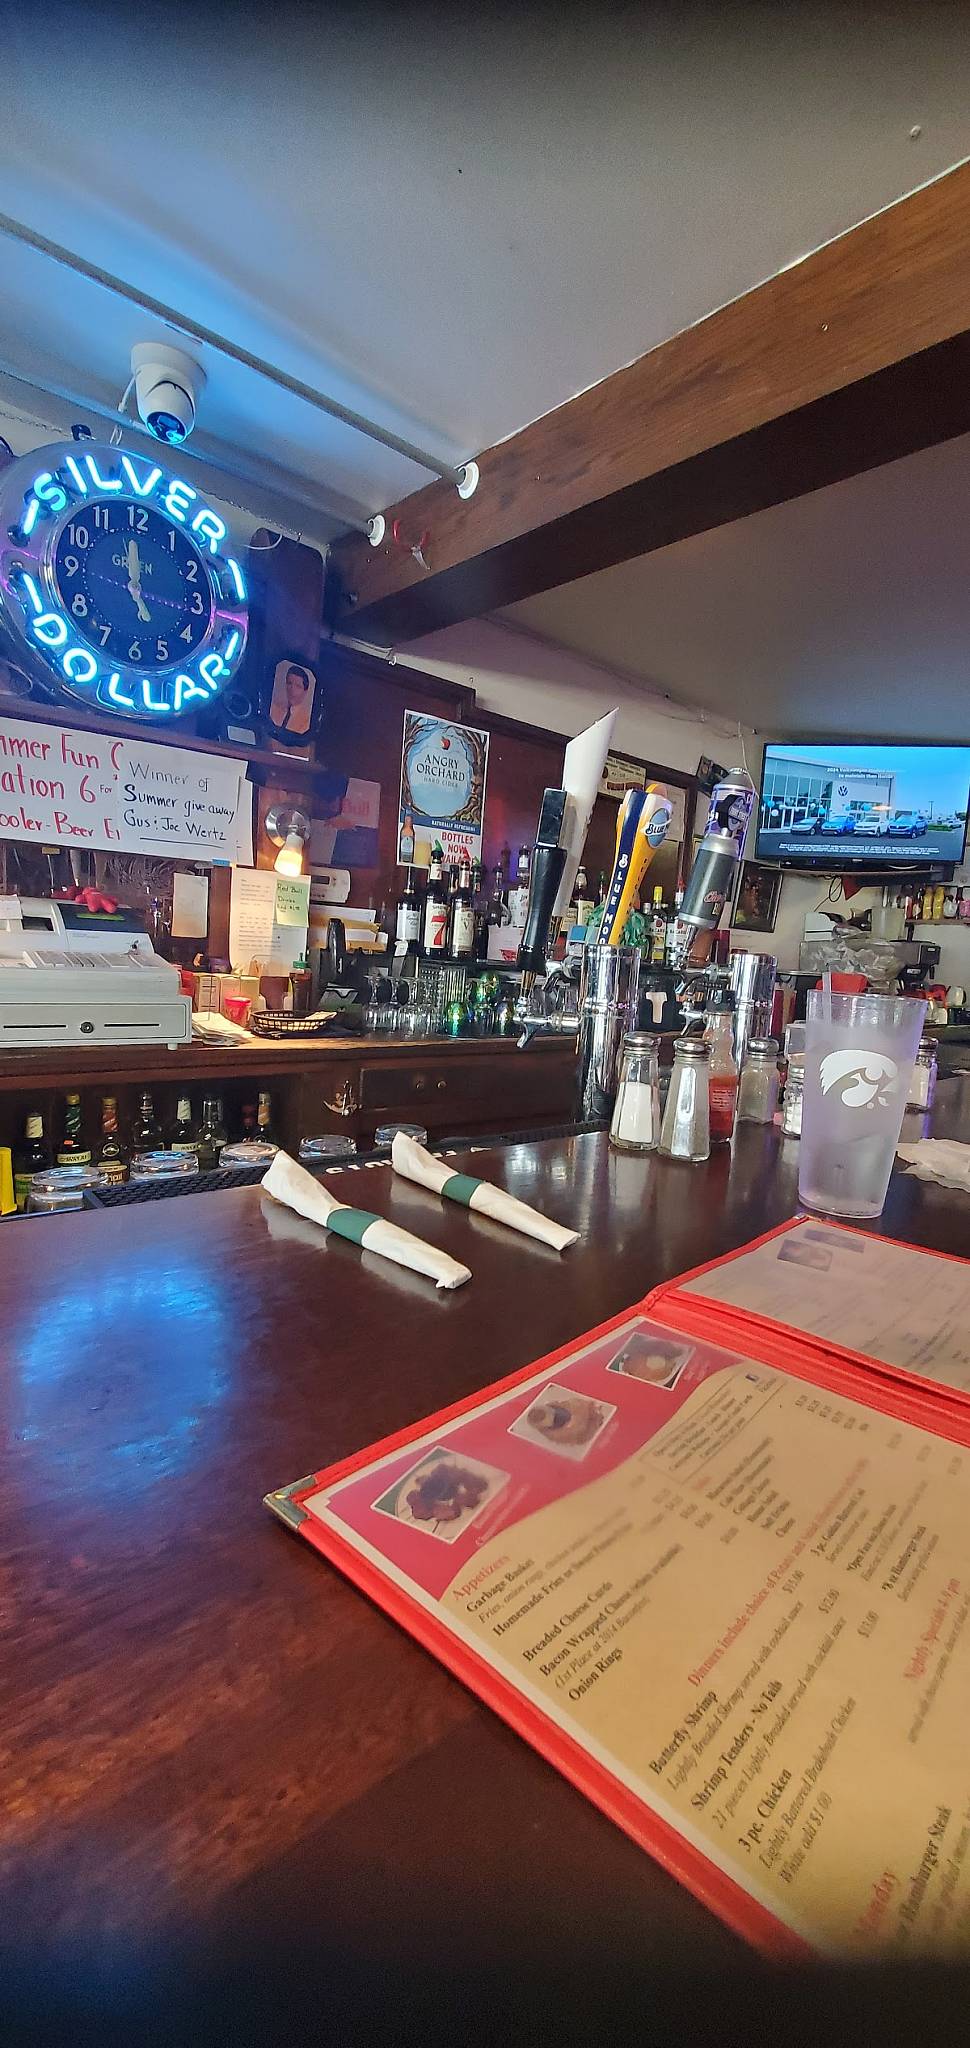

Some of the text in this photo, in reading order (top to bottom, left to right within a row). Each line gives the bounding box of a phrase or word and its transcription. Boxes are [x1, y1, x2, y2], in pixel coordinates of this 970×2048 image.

[33, 455, 227, 554] SILVER
[93, 506, 109, 530] 11
[127, 505, 149, 530] 12
[68, 523, 89, 549] 10
[168, 531, 176, 551] 1
[64, 555, 80, 577] 9
[186, 560, 198, 583] 2
[71, 593, 88, 617] 8
[191, 592, 204, 615] 3
[99, 626, 112, 646] 7
[179, 624, 194, 644] 4
[32, 612, 231, 711] DOLLAR
[128, 641, 142, 661] 6
[155, 641, 168, 660] 5
[61, 733, 100, 769] Fun
[424, 754, 460, 770] ANGRY
[129, 761, 212, 793] Winner of
[416, 763, 466, 782] ORCHARD
[423, 776, 459, 789] HARD CIDER
[79, 774, 96, 804] 6
[99, 784, 113, 794] For
[123, 784, 179, 808] Summer
[160, 817, 181, 831] Joe
[185, 822, 227, 841] Wertz
[441, 831, 474, 845] BOTTLES
[645, 823, 664, 835] BLUE
[447, 844, 467, 854] NOW
[611, 853, 629, 906] BLUE
[431, 915, 449, 946] 7
[452, 1555, 510, 1600] Appetizers
[466, 1580, 506, 1612] Garbage
[492, 1593, 544, 1636] Homemade
[540, 1576, 564, 1594] Fries
[521, 1624, 562, 1661] Breaded
[559, 1601, 590, 1627] Cheese
[538, 1647, 570, 1676] Bacon
[565, 1611, 607, 1647] Wrapped
[687, 1647, 724, 1687] Dinners
[717, 1614, 750, 1649] include
[745, 1587, 770, 1616] choice
[568, 1647, 622, 1700] Onion Rings
[648, 1728, 691, 1775] Butterfly
[683, 1690, 718, 1727] Shrimp
[690, 1765, 728, 1811] Shrimp
[718, 1723, 754, 1766] Tenders
[750, 1702, 768, 1714] No
[760, 1680, 782, 1702] Tails
[737, 1837, 751, 1852] 3
[746, 1822, 764, 1844] pc.
[756, 1768, 792, 1818] Chicken
[927, 1806, 951, 1841] Steak
